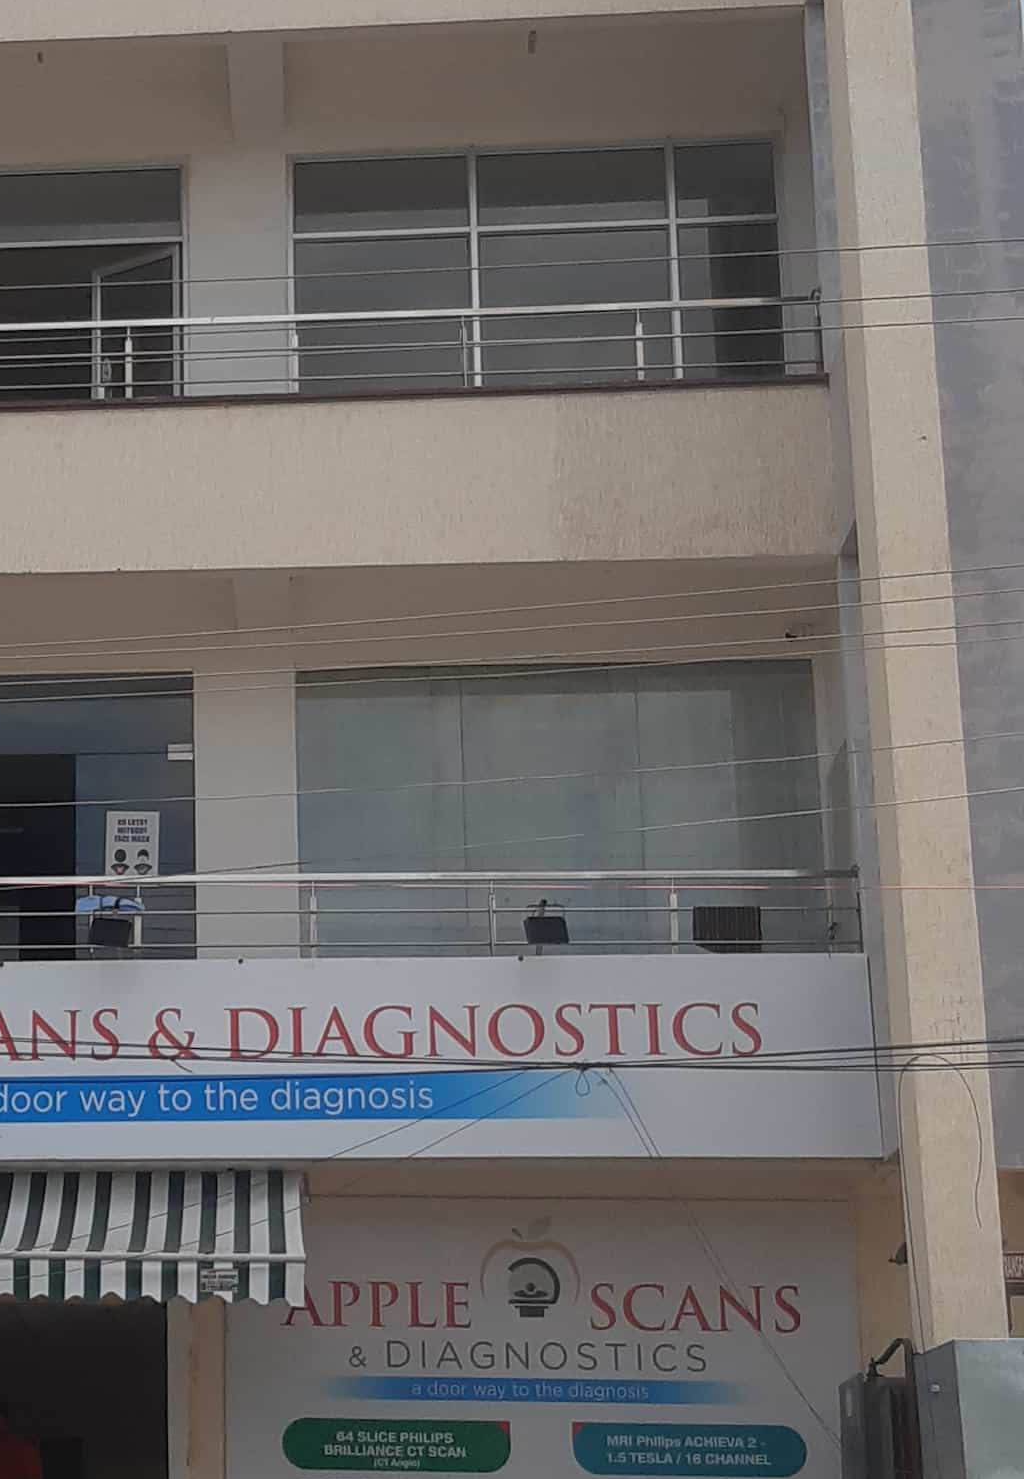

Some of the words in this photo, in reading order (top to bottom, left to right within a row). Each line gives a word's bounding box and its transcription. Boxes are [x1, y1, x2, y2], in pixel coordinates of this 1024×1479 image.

[147, 1007, 200, 1062] &
[224, 1002, 762, 1061] DIAGNOSTICS
[79, 1088, 147, 1118] way
[158, 1085, 192, 1112] to
[204, 1081, 258, 1111] the
[270, 1080, 433, 1118] diagnosis
[280, 1280, 472, 1328] APPLE
[590, 1282, 802, 1334] SCANS
[349, 1345, 367, 1368] &
[386, 1340, 707, 1373] DIAGNOSTICS
[412, 1383, 422, 1396] a
[428, 1380, 466, 1396] door
[473, 1383, 506, 1400] way
[512, 1381, 530, 1397] to
[535, 1381, 562, 1397] the
[568, 1381, 650, 1401] diagnosis
[336, 1431, 354, 1442] 64
[357, 1431, 396, 1443] SLICE
[400, 1432, 454, 1444] PHILIPS
[607, 1435, 633, 1446] MRI
[637, 1436, 681, 1450] Philips
[684, 1436, 744, 1448] ACHIEVA
[747, 1438, 757, 1449] 2
[324, 1444, 403, 1457] BRILLIANCE
[407, 1445, 425, 1457] CT
[428, 1446, 467, 1458] SCAN
[629, 1452, 673, 1464] TESLA
[686, 1453, 702, 1465] 16
[705, 1453, 772, 1466] CHANNEL
